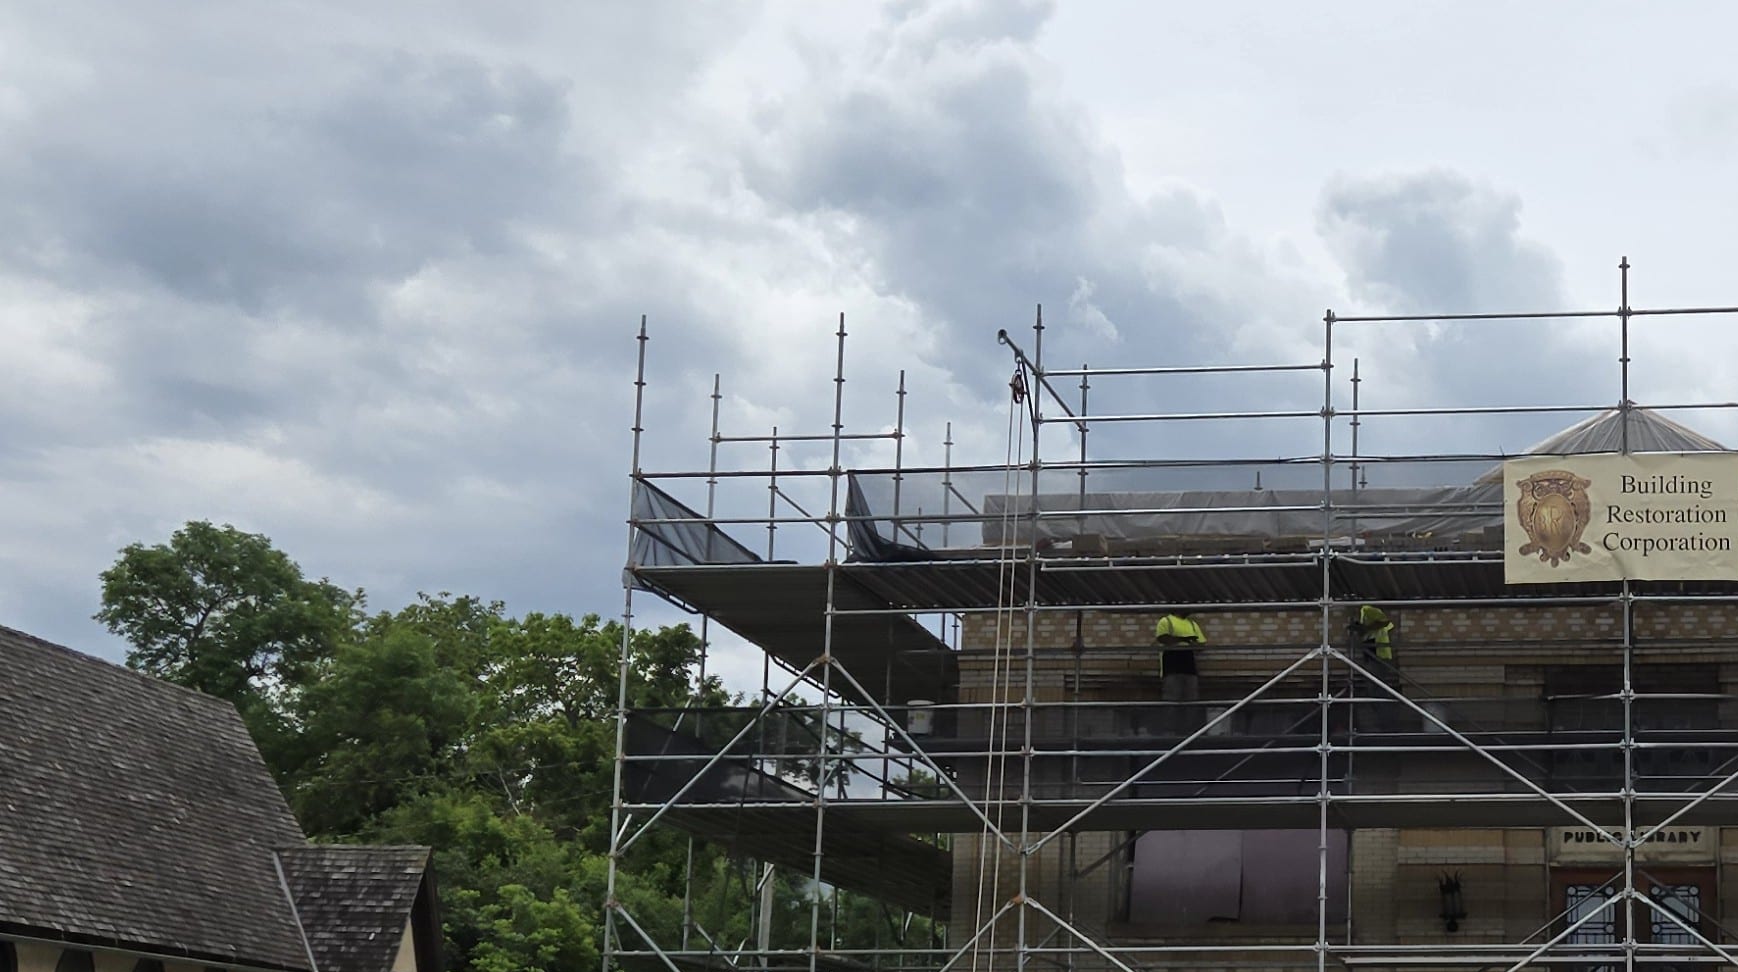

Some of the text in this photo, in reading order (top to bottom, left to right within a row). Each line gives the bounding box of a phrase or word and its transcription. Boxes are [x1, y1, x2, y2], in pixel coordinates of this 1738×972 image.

[1620, 474, 1713, 498] Building
[1606, 504, 1727, 524] Restoration
[1602, 532, 1731, 557] Corporation
